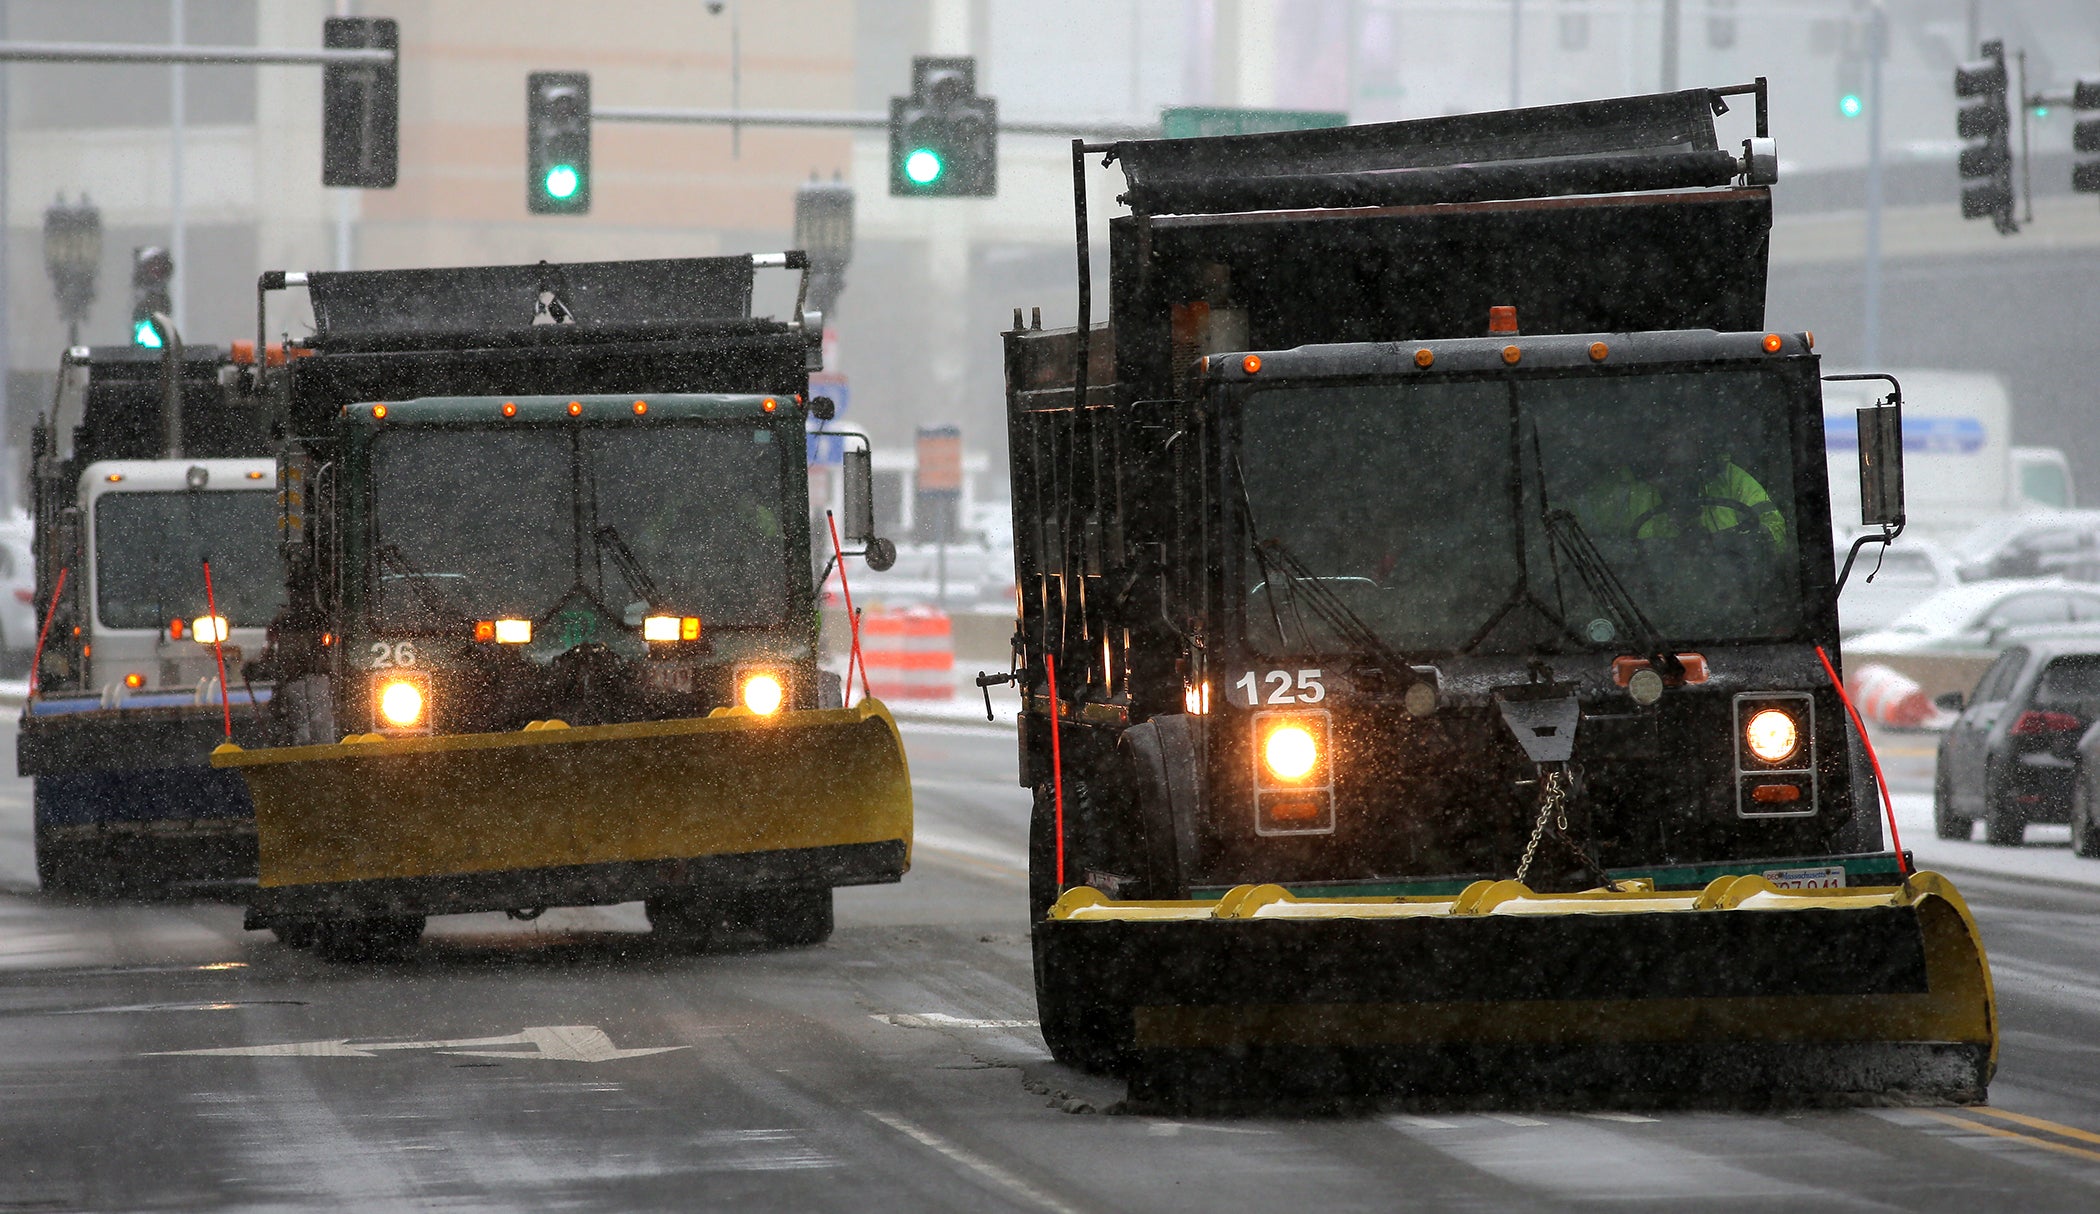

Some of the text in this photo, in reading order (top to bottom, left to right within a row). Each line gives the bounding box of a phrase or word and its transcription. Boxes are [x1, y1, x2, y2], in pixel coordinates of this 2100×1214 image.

[371, 641, 416, 667] 26
[1236, 669, 1325, 705] 125
[1782, 870, 1826, 880] Massachusetts
